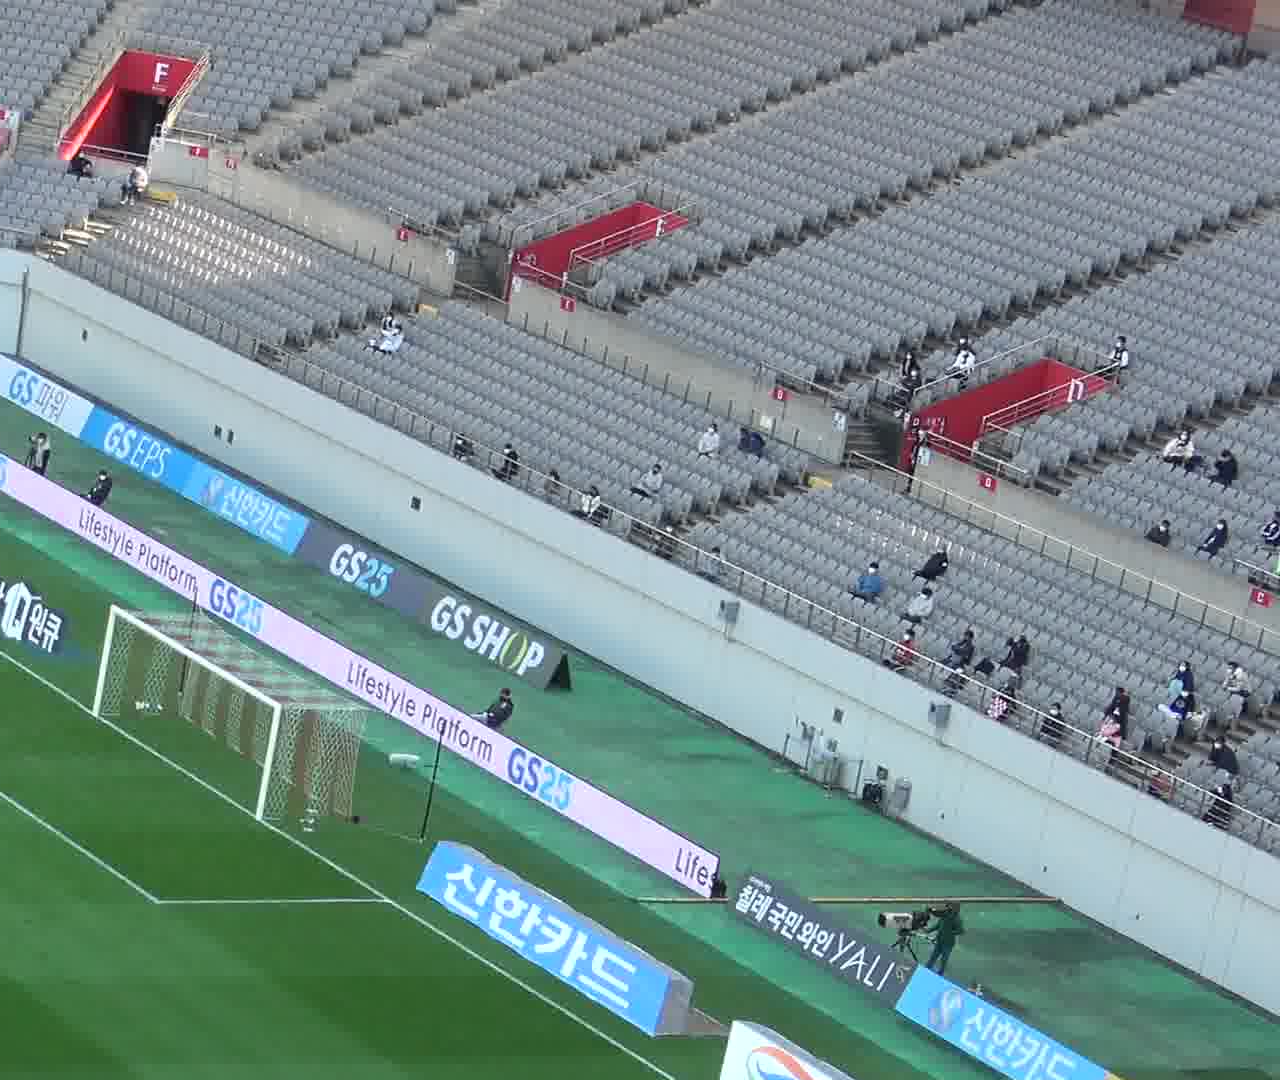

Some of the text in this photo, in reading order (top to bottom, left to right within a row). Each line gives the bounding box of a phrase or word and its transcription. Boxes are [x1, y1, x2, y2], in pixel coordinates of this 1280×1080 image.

[154, 62, 170, 83] F
[78, 507, 265, 634] Lifestyle Platform GS25
[329, 543, 395, 598] GS25
[430, 596, 545, 676] GS SHOP
[346, 661, 576, 811] Lifestyle Platform GS25
[443, 863, 638, 1009] 신한카드
[735, 884, 774, 922] 칠레
[828, 932, 896, 991] YALI
